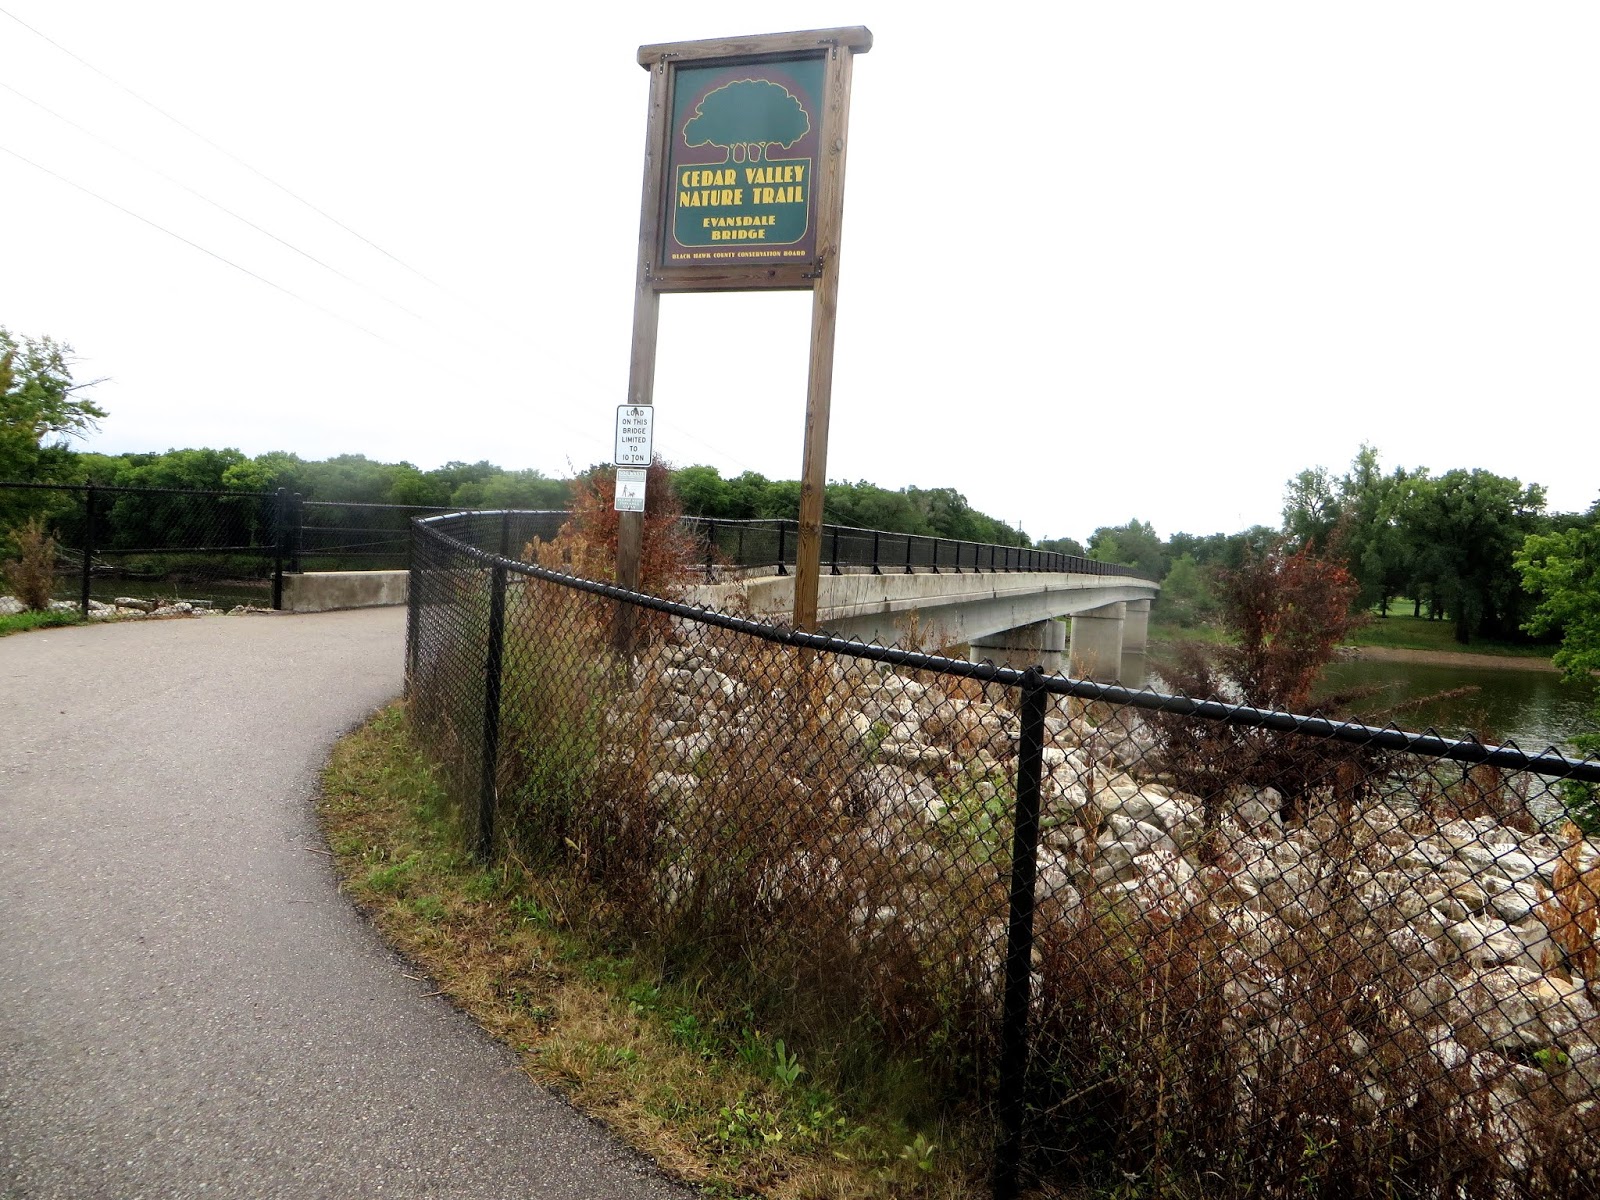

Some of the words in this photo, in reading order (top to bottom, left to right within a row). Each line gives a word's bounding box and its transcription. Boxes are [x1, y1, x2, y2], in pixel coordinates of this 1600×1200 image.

[681, 169, 737, 188] CEDAR
[745, 165, 805, 185] VALLEY
[679, 189, 743, 207] NATURE
[752, 186, 804, 204] TRAIL
[703, 215, 776, 228] EVANSDALE
[711, 229, 766, 241] BRIDGE
[626, 409, 644, 417] LOAD
[633, 418, 648, 426] THIS
